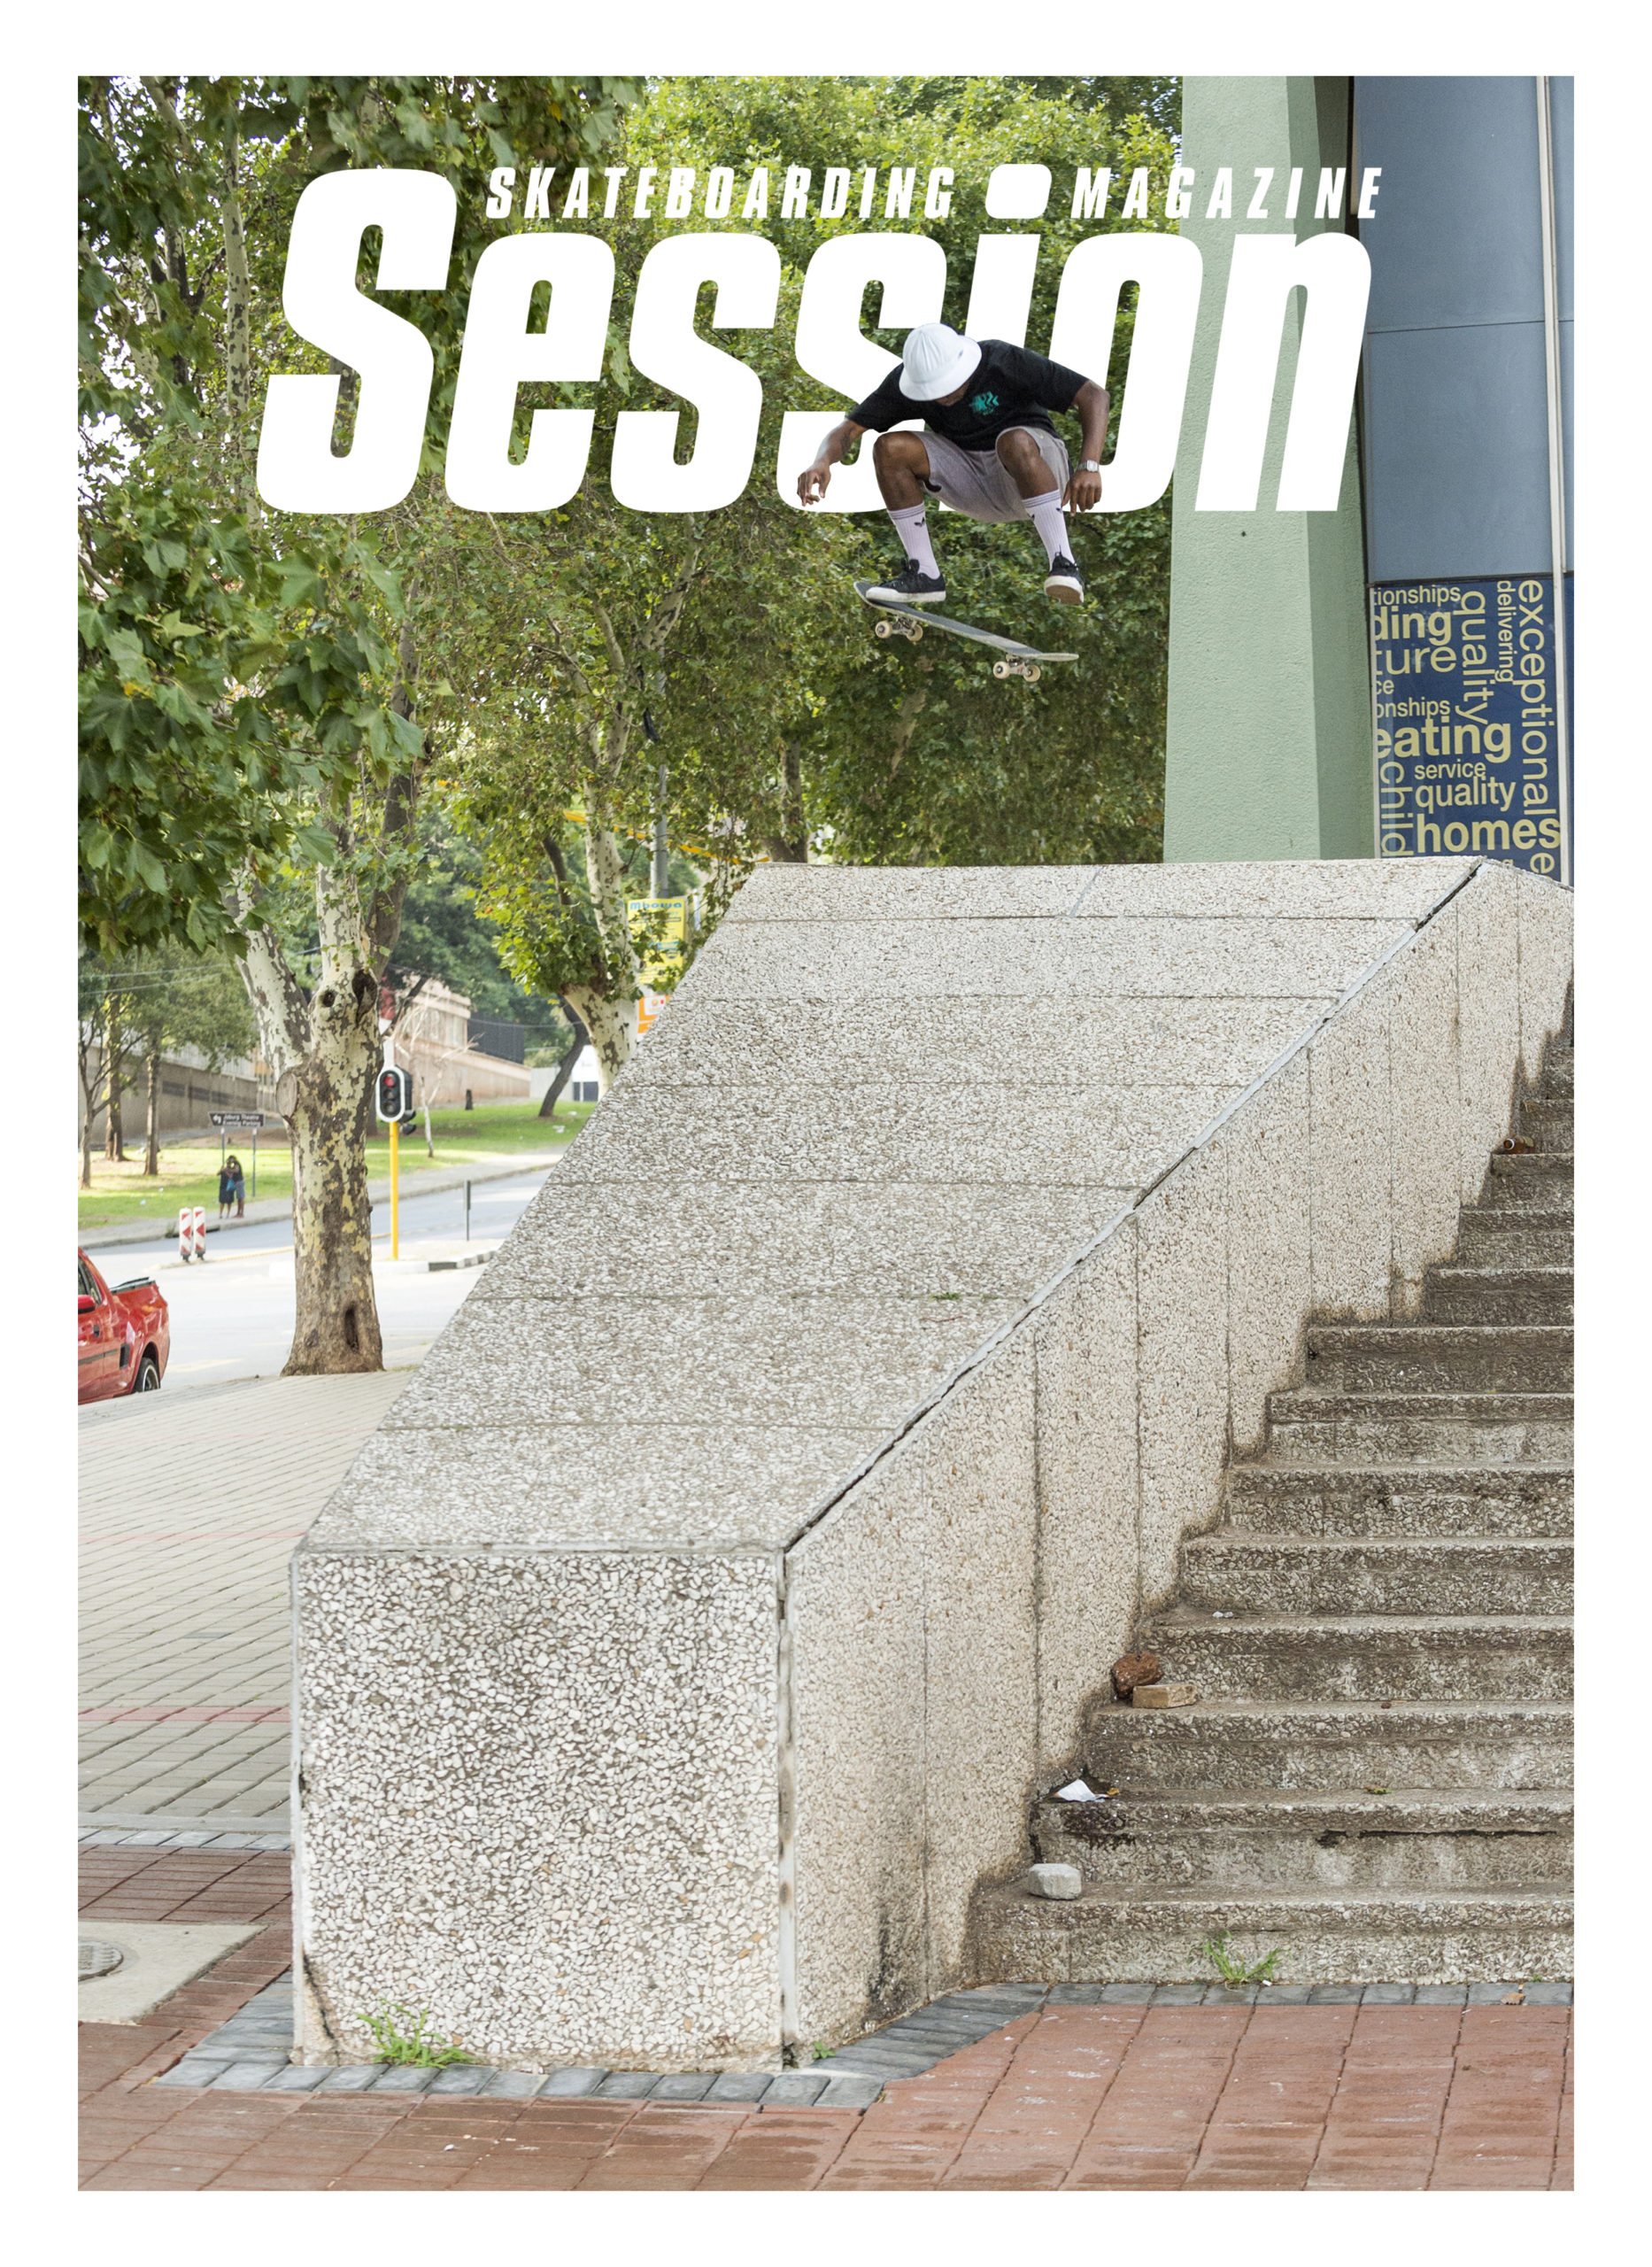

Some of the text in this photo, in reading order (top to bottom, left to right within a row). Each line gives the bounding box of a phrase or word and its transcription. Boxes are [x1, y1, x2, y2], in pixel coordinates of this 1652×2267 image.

[1374, 584, 1461, 607] ionships
[1374, 605, 1451, 646] ding
[1494, 580, 1517, 683] delivering
[1453, 591, 1495, 725] quality
[1512, 579, 1556, 815] exceptional
[1378, 716, 1511, 763] eating
[1414, 758, 1486, 779] service
[1379, 762, 1415, 856] child
[1415, 776, 1517, 815] quality
[1417, 812, 1561, 854] homes
